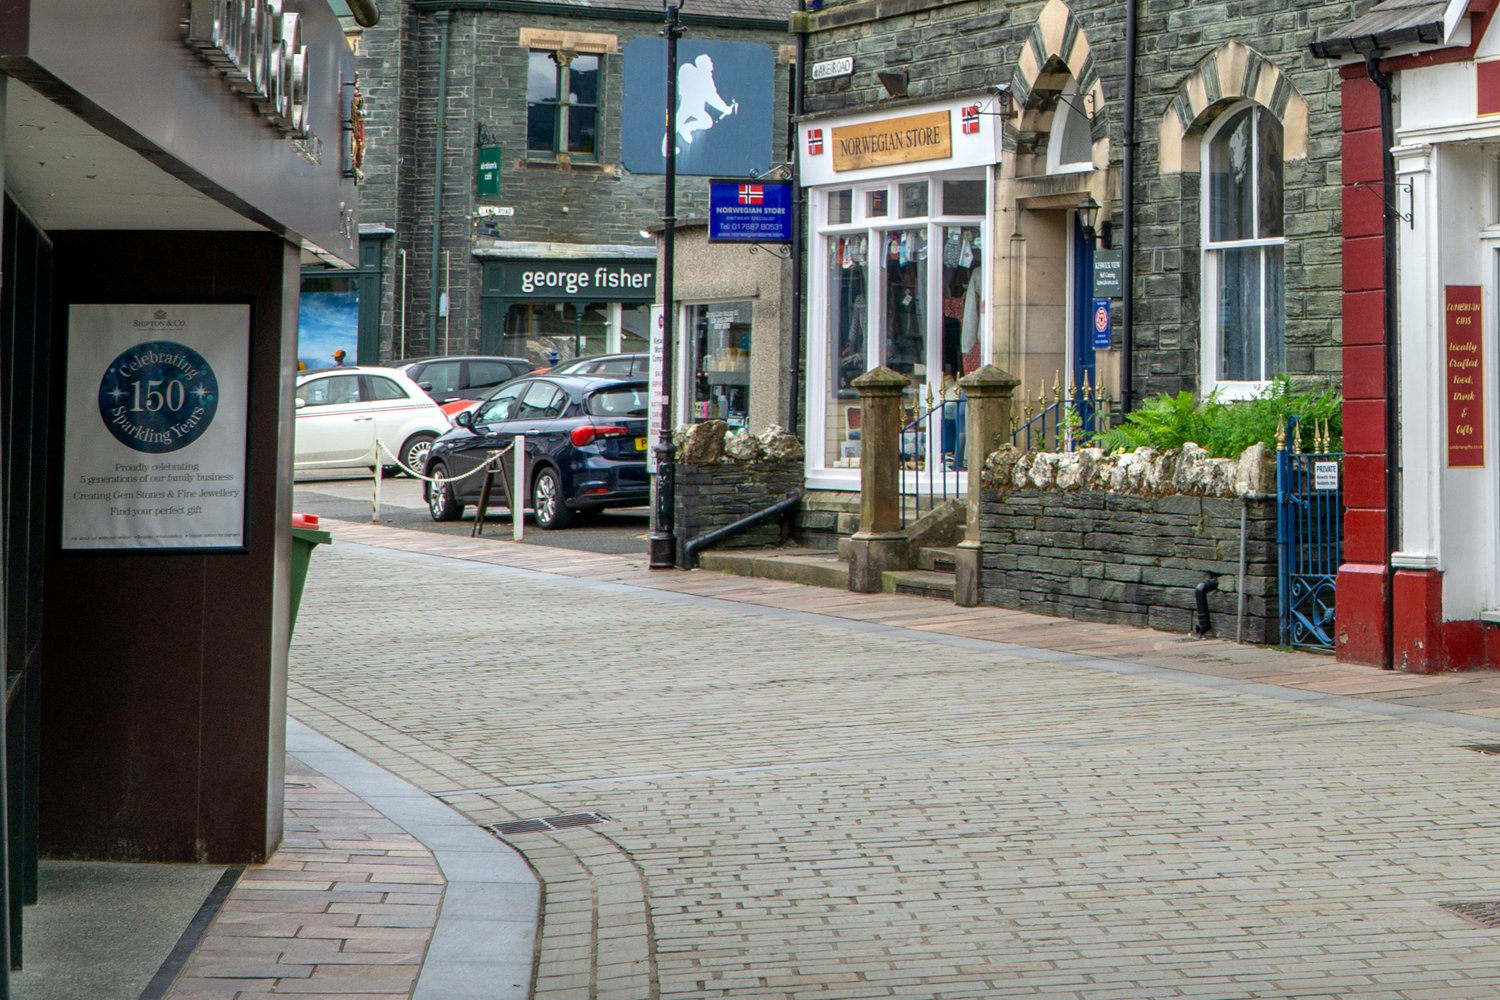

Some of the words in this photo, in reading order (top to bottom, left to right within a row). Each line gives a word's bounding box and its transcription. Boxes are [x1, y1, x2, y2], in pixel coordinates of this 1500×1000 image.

[831, 59, 852, 74] ROAD
[840, 131, 904, 158] NORWEGIAN
[906, 126, 941, 147] STORE
[521, 270, 589, 293] george
[594, 267, 652, 288] fisher
[1446, 302, 1481, 312] CUMBRIAN
[1449, 341, 1477, 353] Locally
[119, 350, 200, 381] Celebrating
[1448, 358, 1479, 370] Crafted
[129, 379, 185, 412] 150
[1453, 391, 1475, 400] Drink
[1461, 407, 1468, 418] &
[112, 404, 173, 446] Sparkling
[170, 406, 205, 438] Years
[1456, 424, 1473, 436] Gifts
[115, 463, 149, 472] Proudly
[150, 462, 200, 472] celebrating
[1316, 465, 1337, 473] PRIVATE
[79, 475, 85, 483] 5
[87, 475, 138, 486] generations
[139, 474, 148, 483] of
[167, 473, 195, 484] family
[196, 473, 234, 482] business
[73, 491, 112, 501] Creating
[113, 491, 134, 500] Gem
[135, 490, 165, 499] Stones
[166, 490, 175, 499] &
[177, 489, 197, 498] Fine
[198, 488, 241, 499] Jewellery
[110, 507, 131, 516] Find
[131, 509, 151, 518] your
[154, 506, 185, 517] perfect
[187, 506, 203, 517] gift
